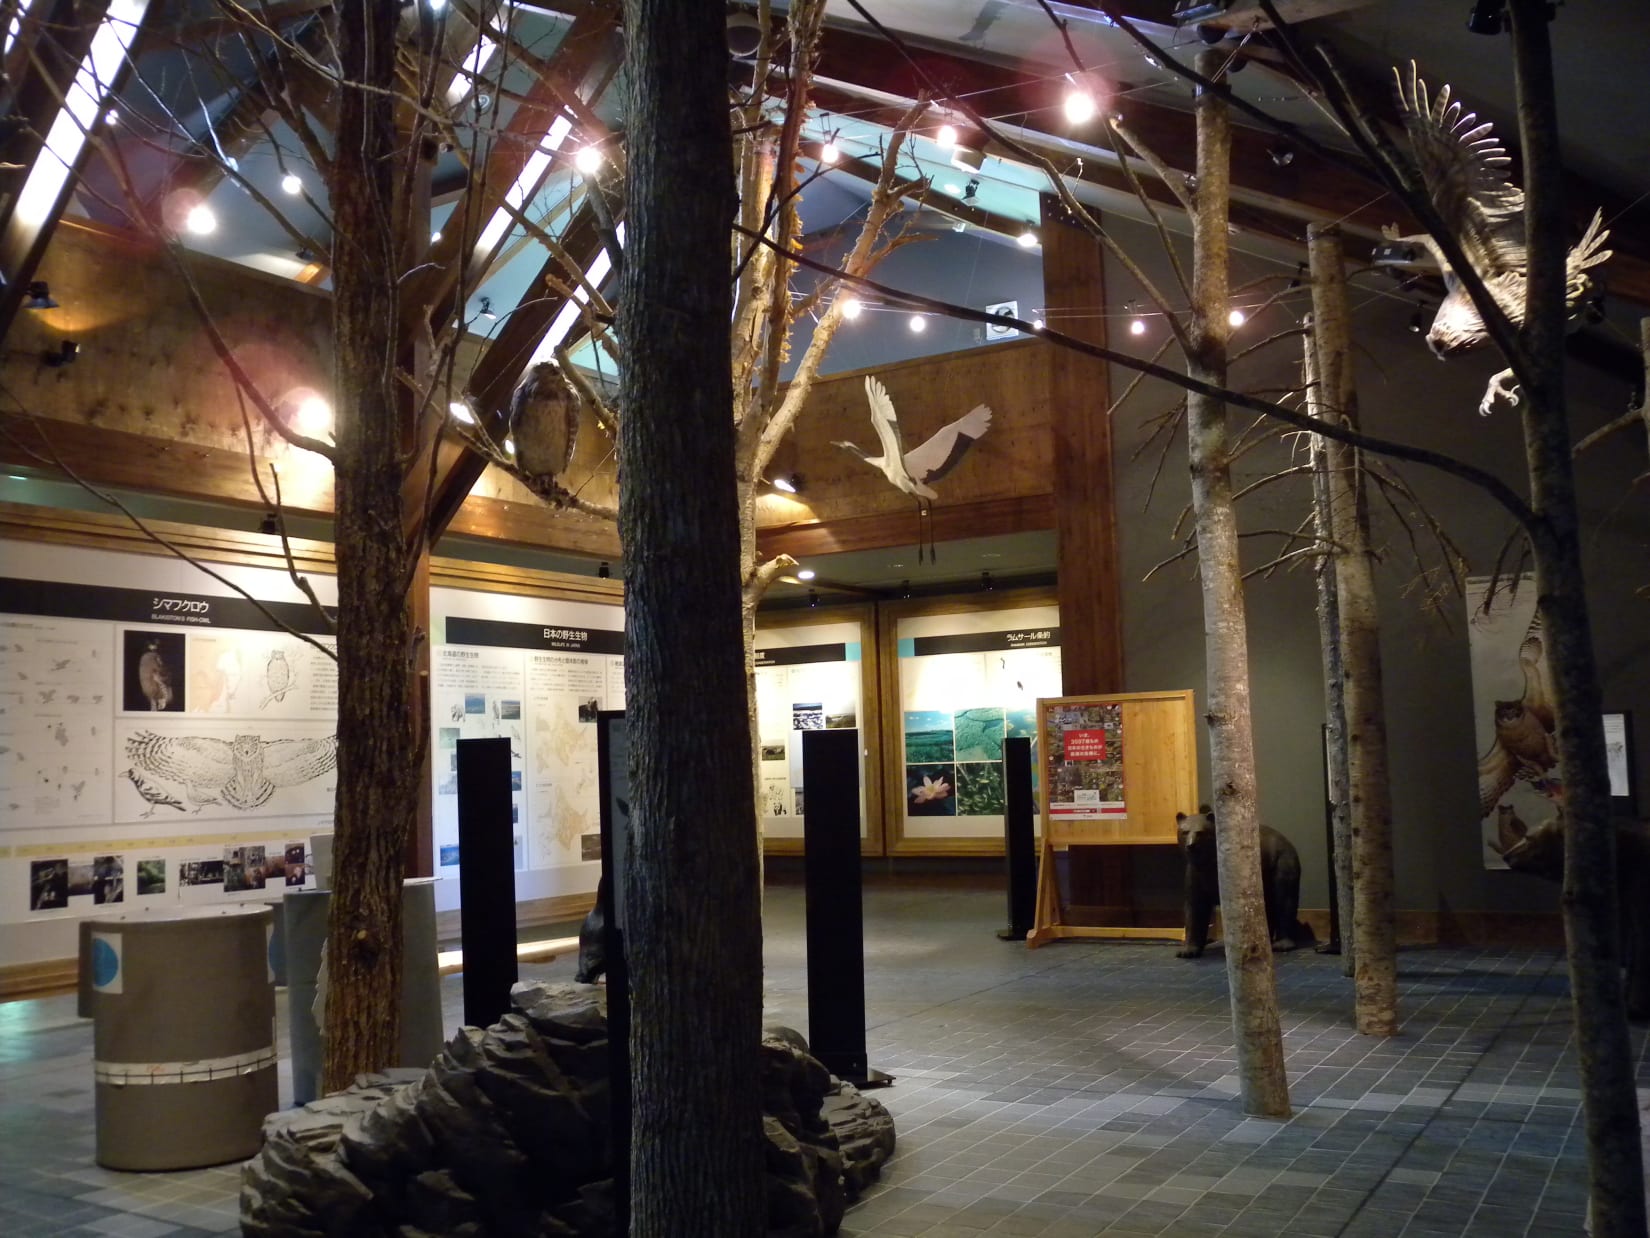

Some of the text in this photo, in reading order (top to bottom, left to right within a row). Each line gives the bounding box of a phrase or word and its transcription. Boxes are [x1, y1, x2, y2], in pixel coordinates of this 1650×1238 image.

[152, 597, 209, 614] シマフクロウ
[543, 628, 588, 641] 日本の野生生物
[1006, 630, 1051, 642] ラムサール条約
